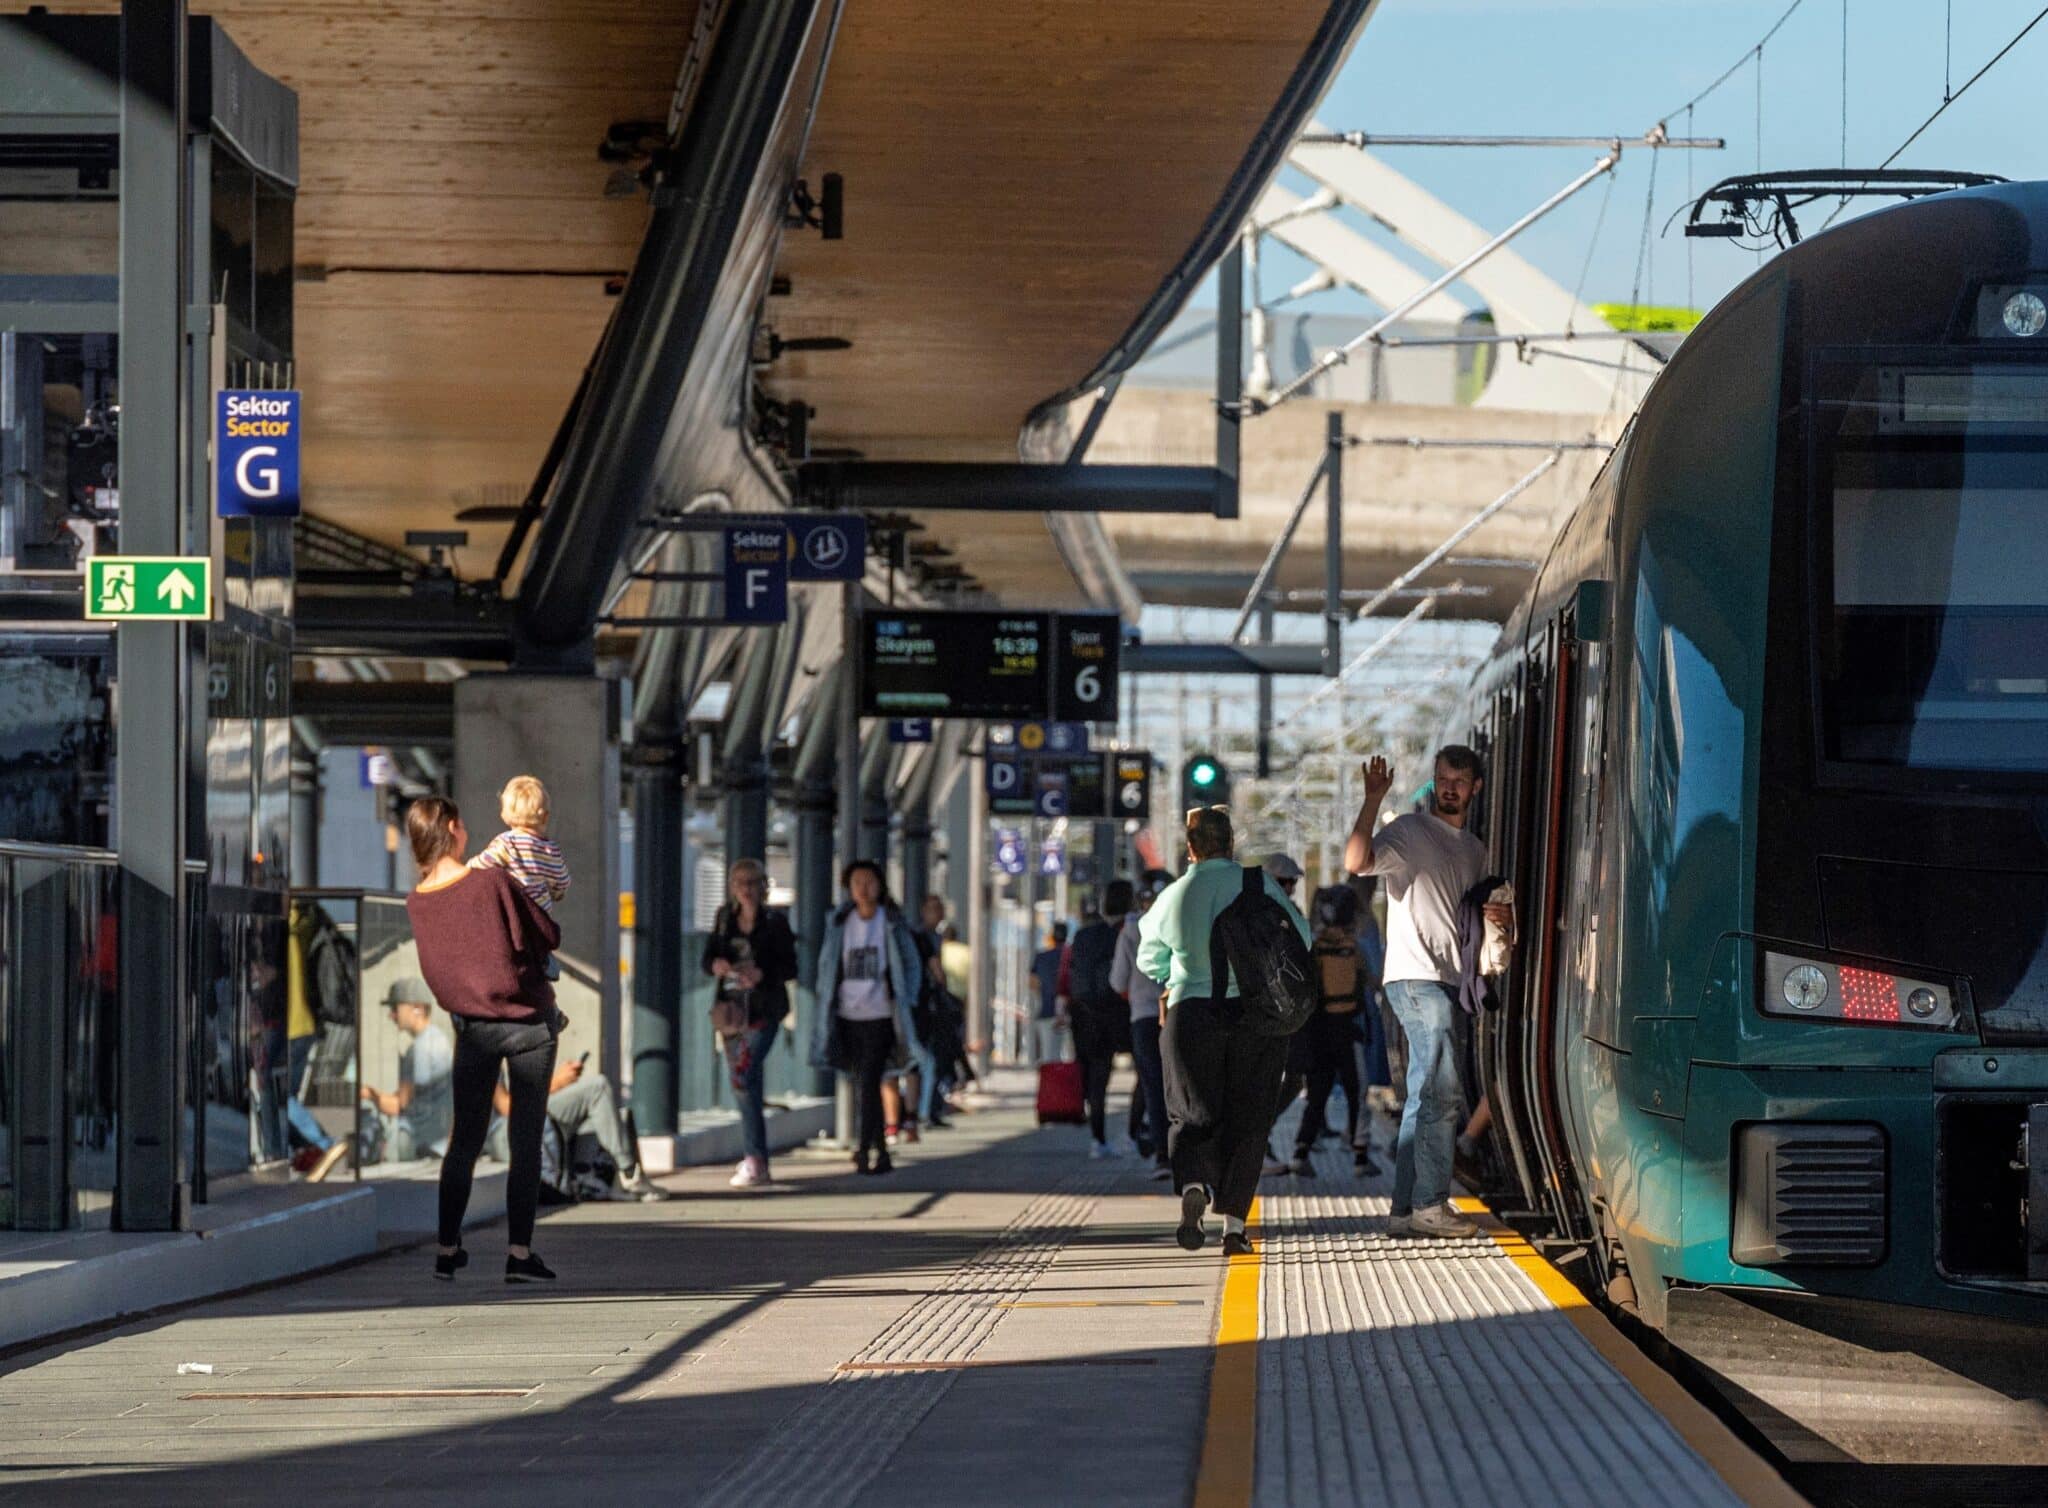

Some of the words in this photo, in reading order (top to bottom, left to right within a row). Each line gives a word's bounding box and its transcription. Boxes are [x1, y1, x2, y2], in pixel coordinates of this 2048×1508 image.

[227, 396, 291, 416] Sektor
[227, 417, 291, 436] Sector
[236, 445, 280, 497] G
[733, 531, 782, 548] Sektor
[746, 569, 769, 608] F
[1075, 665, 1101, 702] 6
[992, 763, 1015, 790] D
[1042, 790, 1063, 814] C
[1121, 781, 1142, 809] 6
